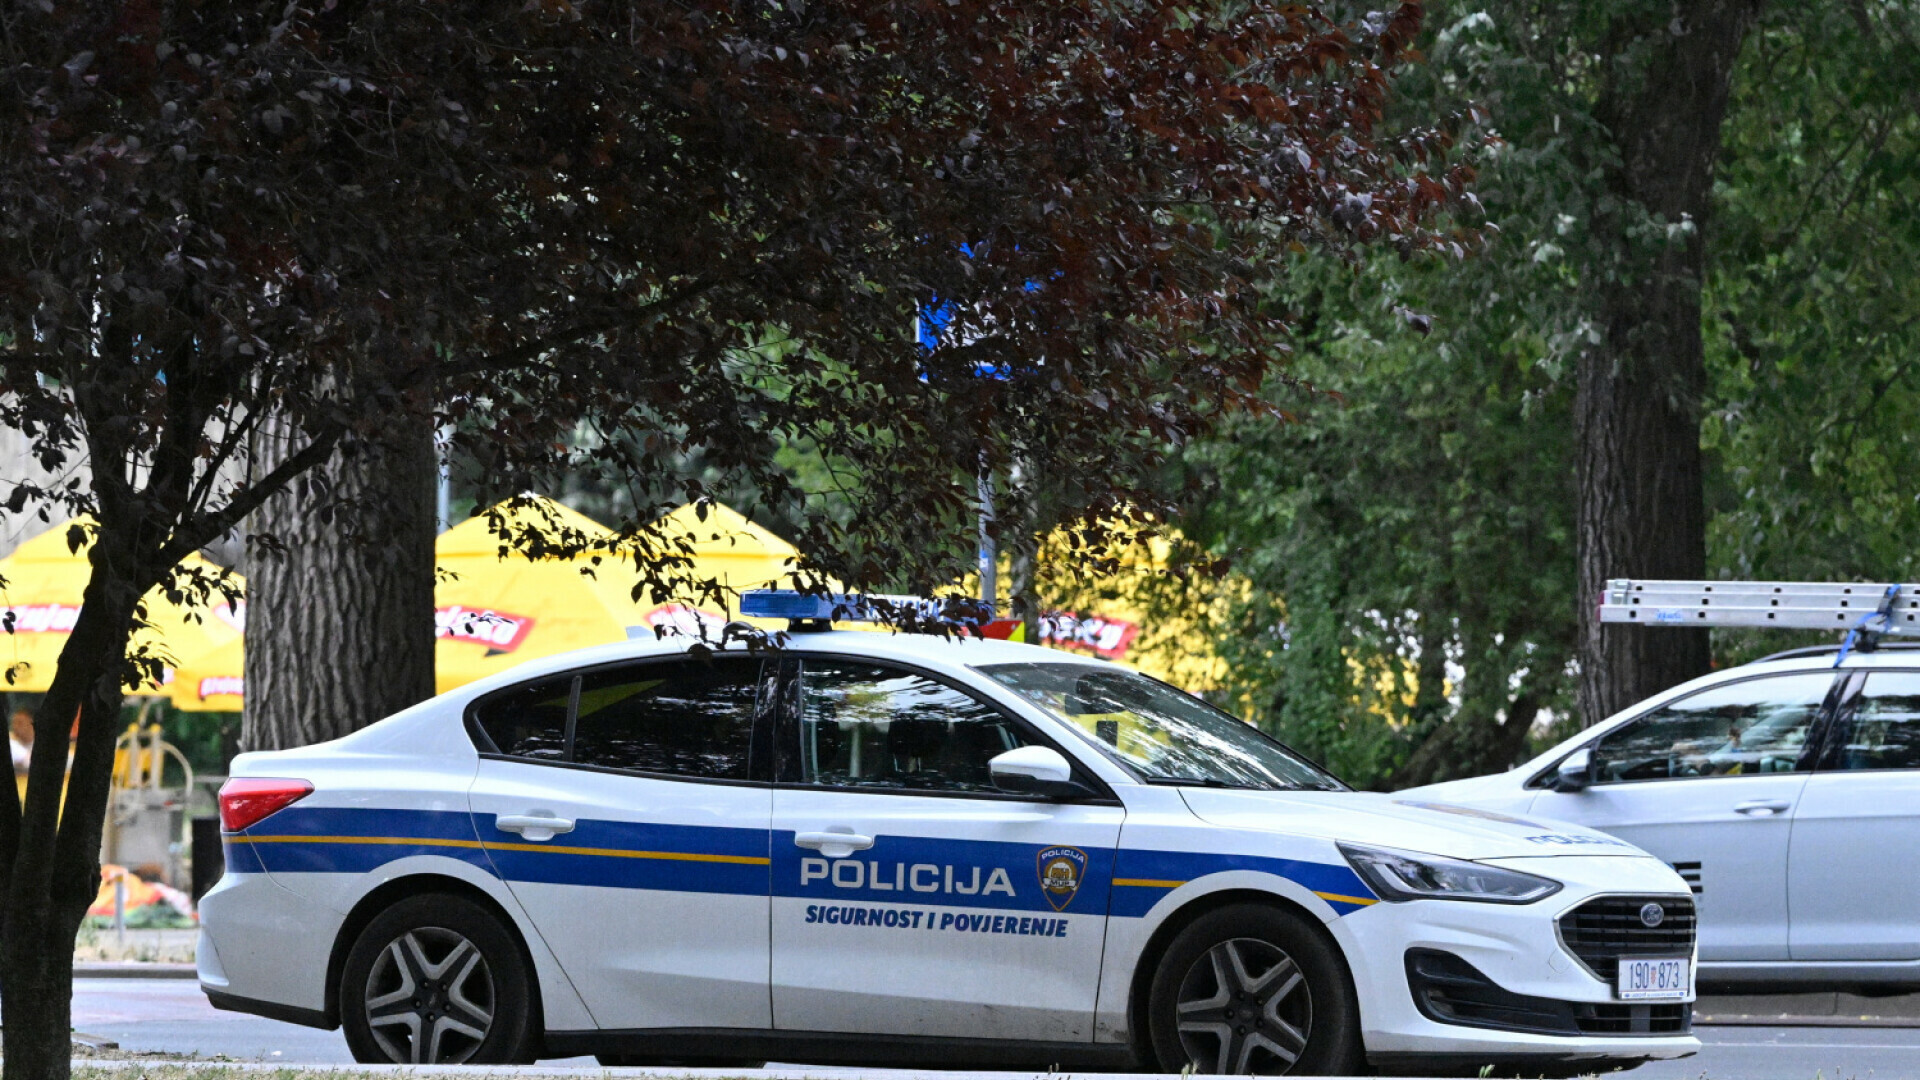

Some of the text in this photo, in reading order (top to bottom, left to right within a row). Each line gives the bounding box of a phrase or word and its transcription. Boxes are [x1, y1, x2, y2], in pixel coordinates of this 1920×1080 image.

[1041, 849, 1084, 864] POLICIJA
[800, 857, 1016, 897] POLICIJA
[805, 905, 1068, 938] SIGURNOST I POVJERENJE
[1630, 961, 1679, 989] 190 873
